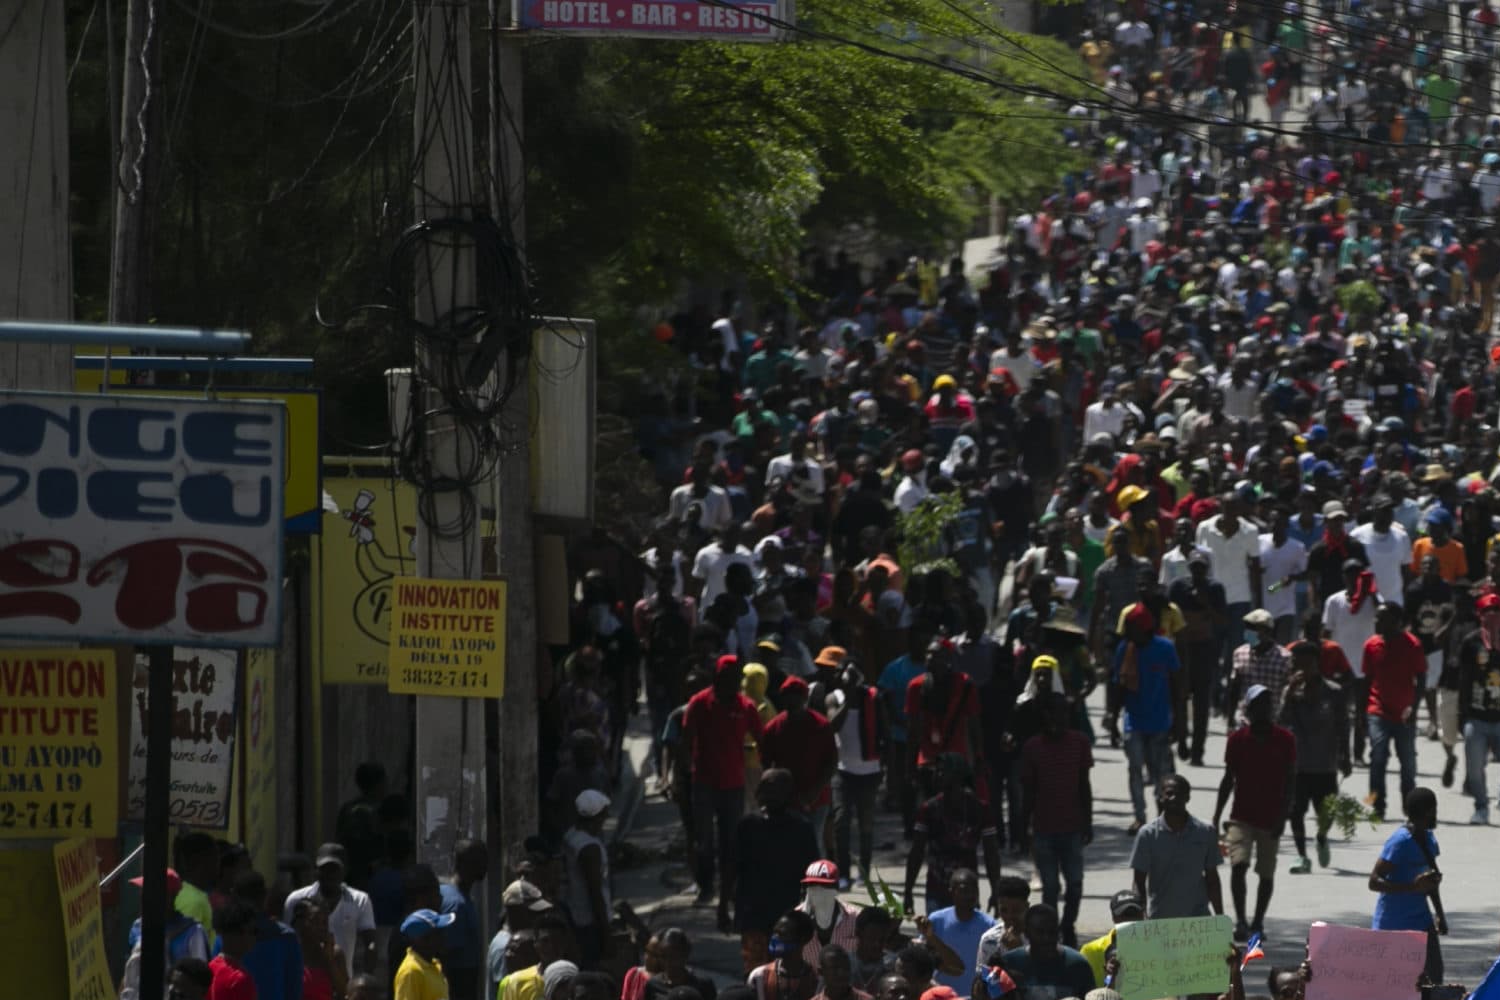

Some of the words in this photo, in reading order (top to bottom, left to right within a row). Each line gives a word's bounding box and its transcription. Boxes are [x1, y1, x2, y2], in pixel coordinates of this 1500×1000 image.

[543, 0, 611, 24] HOTEL
[631, 3, 677, 26] BAR
[698, 5, 769, 29] RESTO
[397, 583, 501, 611] INNOVATION
[401, 611, 495, 634] INSTITUTE
[398, 633, 445, 650] KAFOU
[466, 653, 483, 666] 19
[402, 667, 489, 689] 3832-7474
[55, 772, 83, 793] 19
[0, 800, 94, 830] 2-7474
